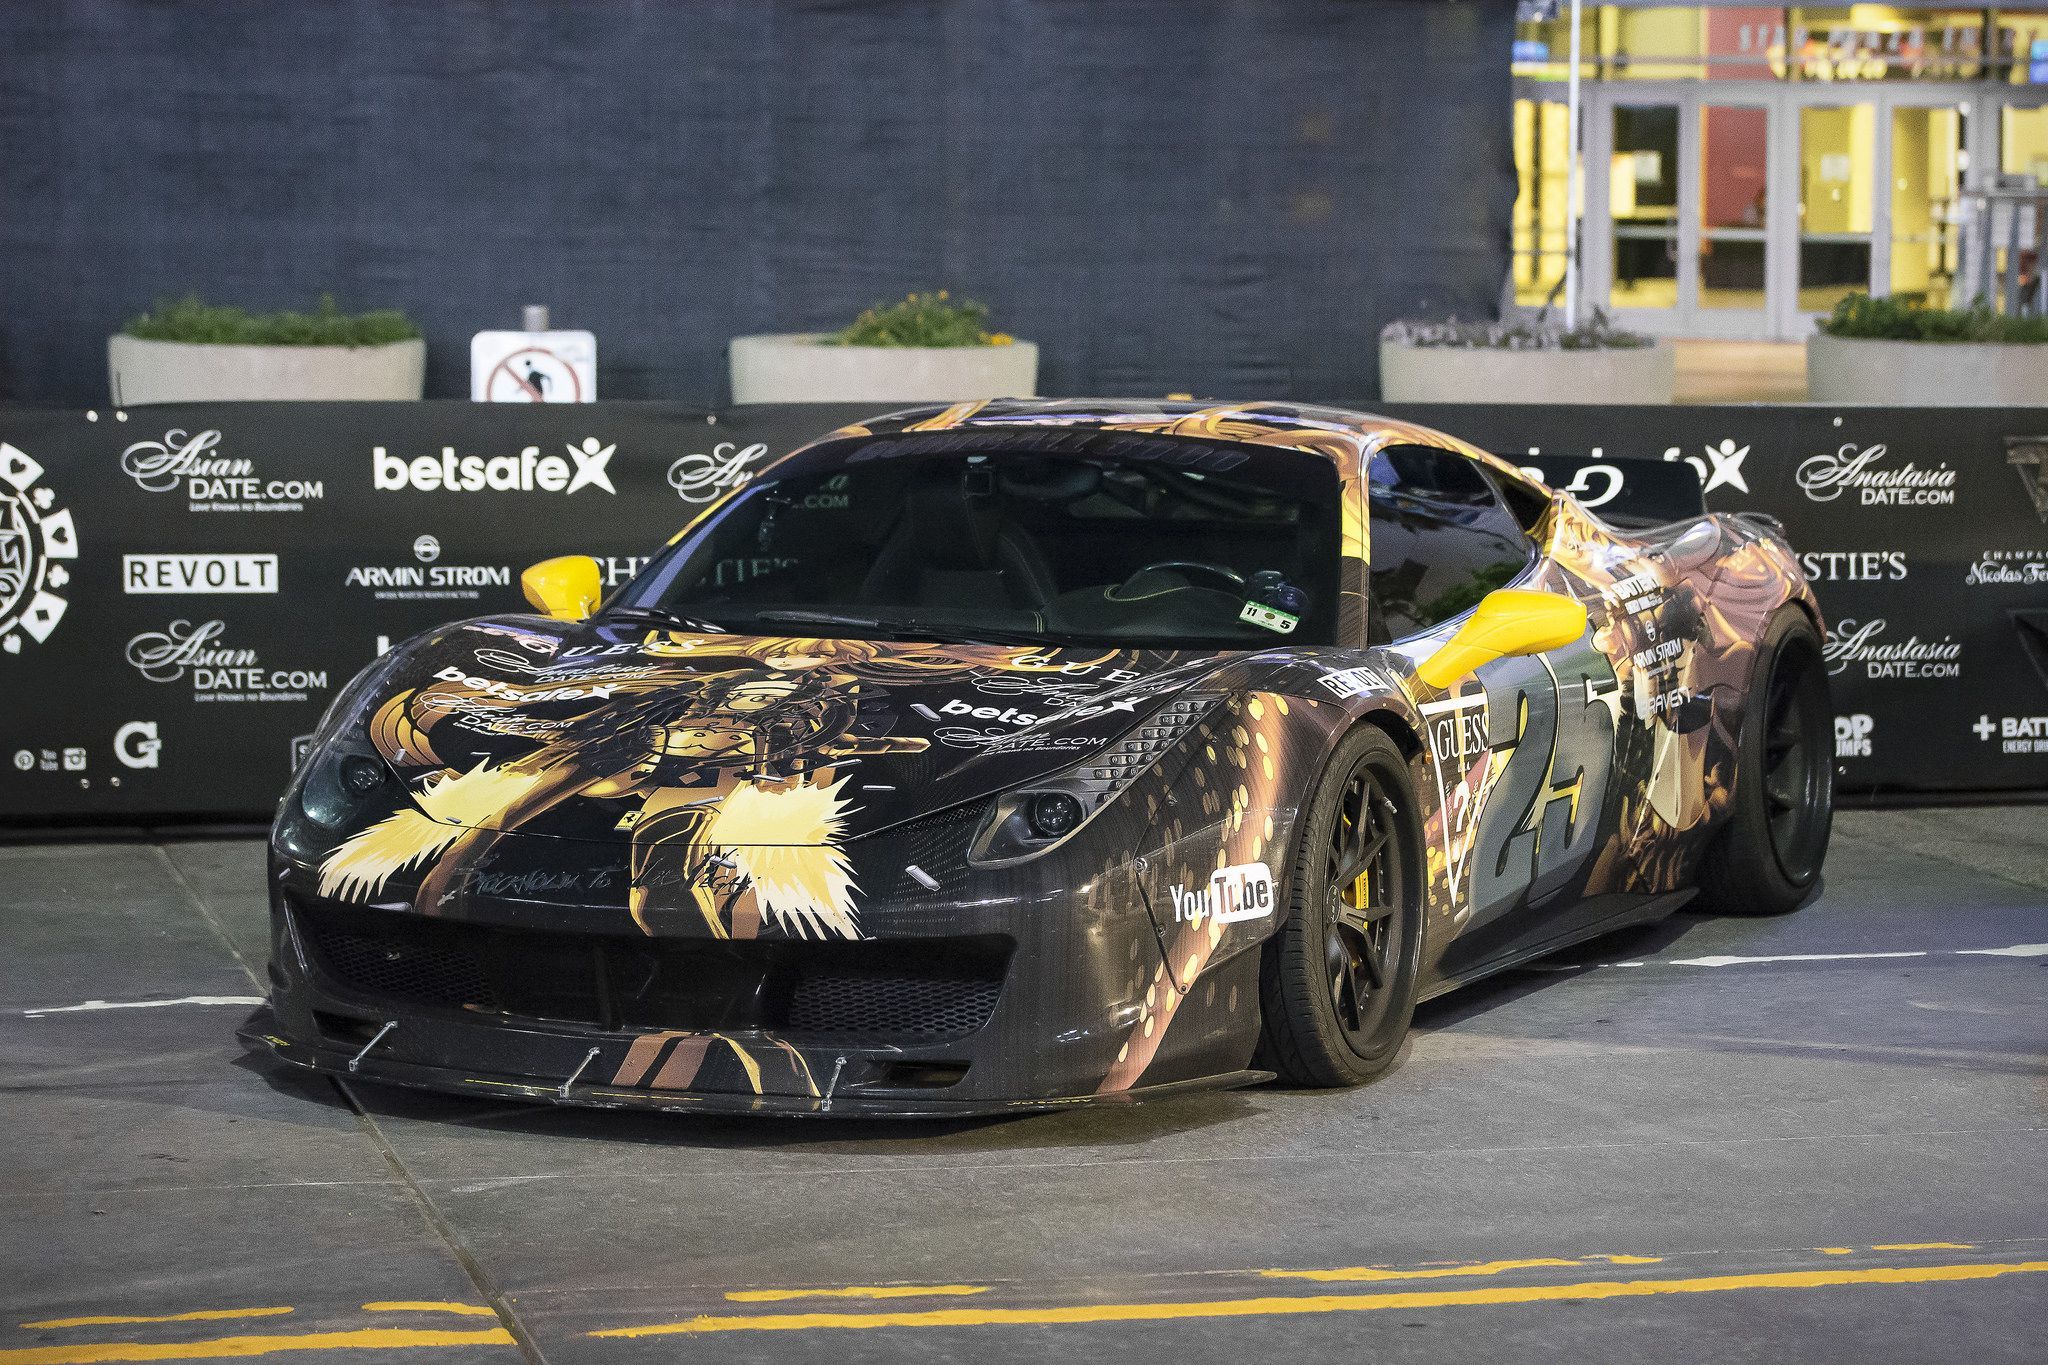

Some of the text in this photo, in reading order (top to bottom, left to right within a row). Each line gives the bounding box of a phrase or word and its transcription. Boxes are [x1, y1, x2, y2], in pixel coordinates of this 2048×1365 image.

[120, 428, 253, 492] Asian
[373, 446, 570, 491] betsafe
[1796, 443, 1956, 501] Anastasia
[189, 478, 323, 500] DATE.COM
[1862, 488, 1954, 505] DATE.COM
[130, 560, 271, 587] REVOLT
[345, 566, 510, 587] ARMIN STROM
[1796, 551, 1907, 581] STIE'S
[1246, 607, 1291, 629] 11 5
[126, 619, 258, 682] Asian
[518, 639, 705, 657] GUESS
[1822, 618, 1961, 676] Anastasia
[194, 669, 327, 690] DATE.COM
[433, 666, 585, 701] betsafe
[1867, 662, 1960, 678] DATE.COM
[459, 715, 575, 731] DATE.COM
[1437, 711, 1489, 761] GUESS
[1169, 872, 1269, 923] YouTube
